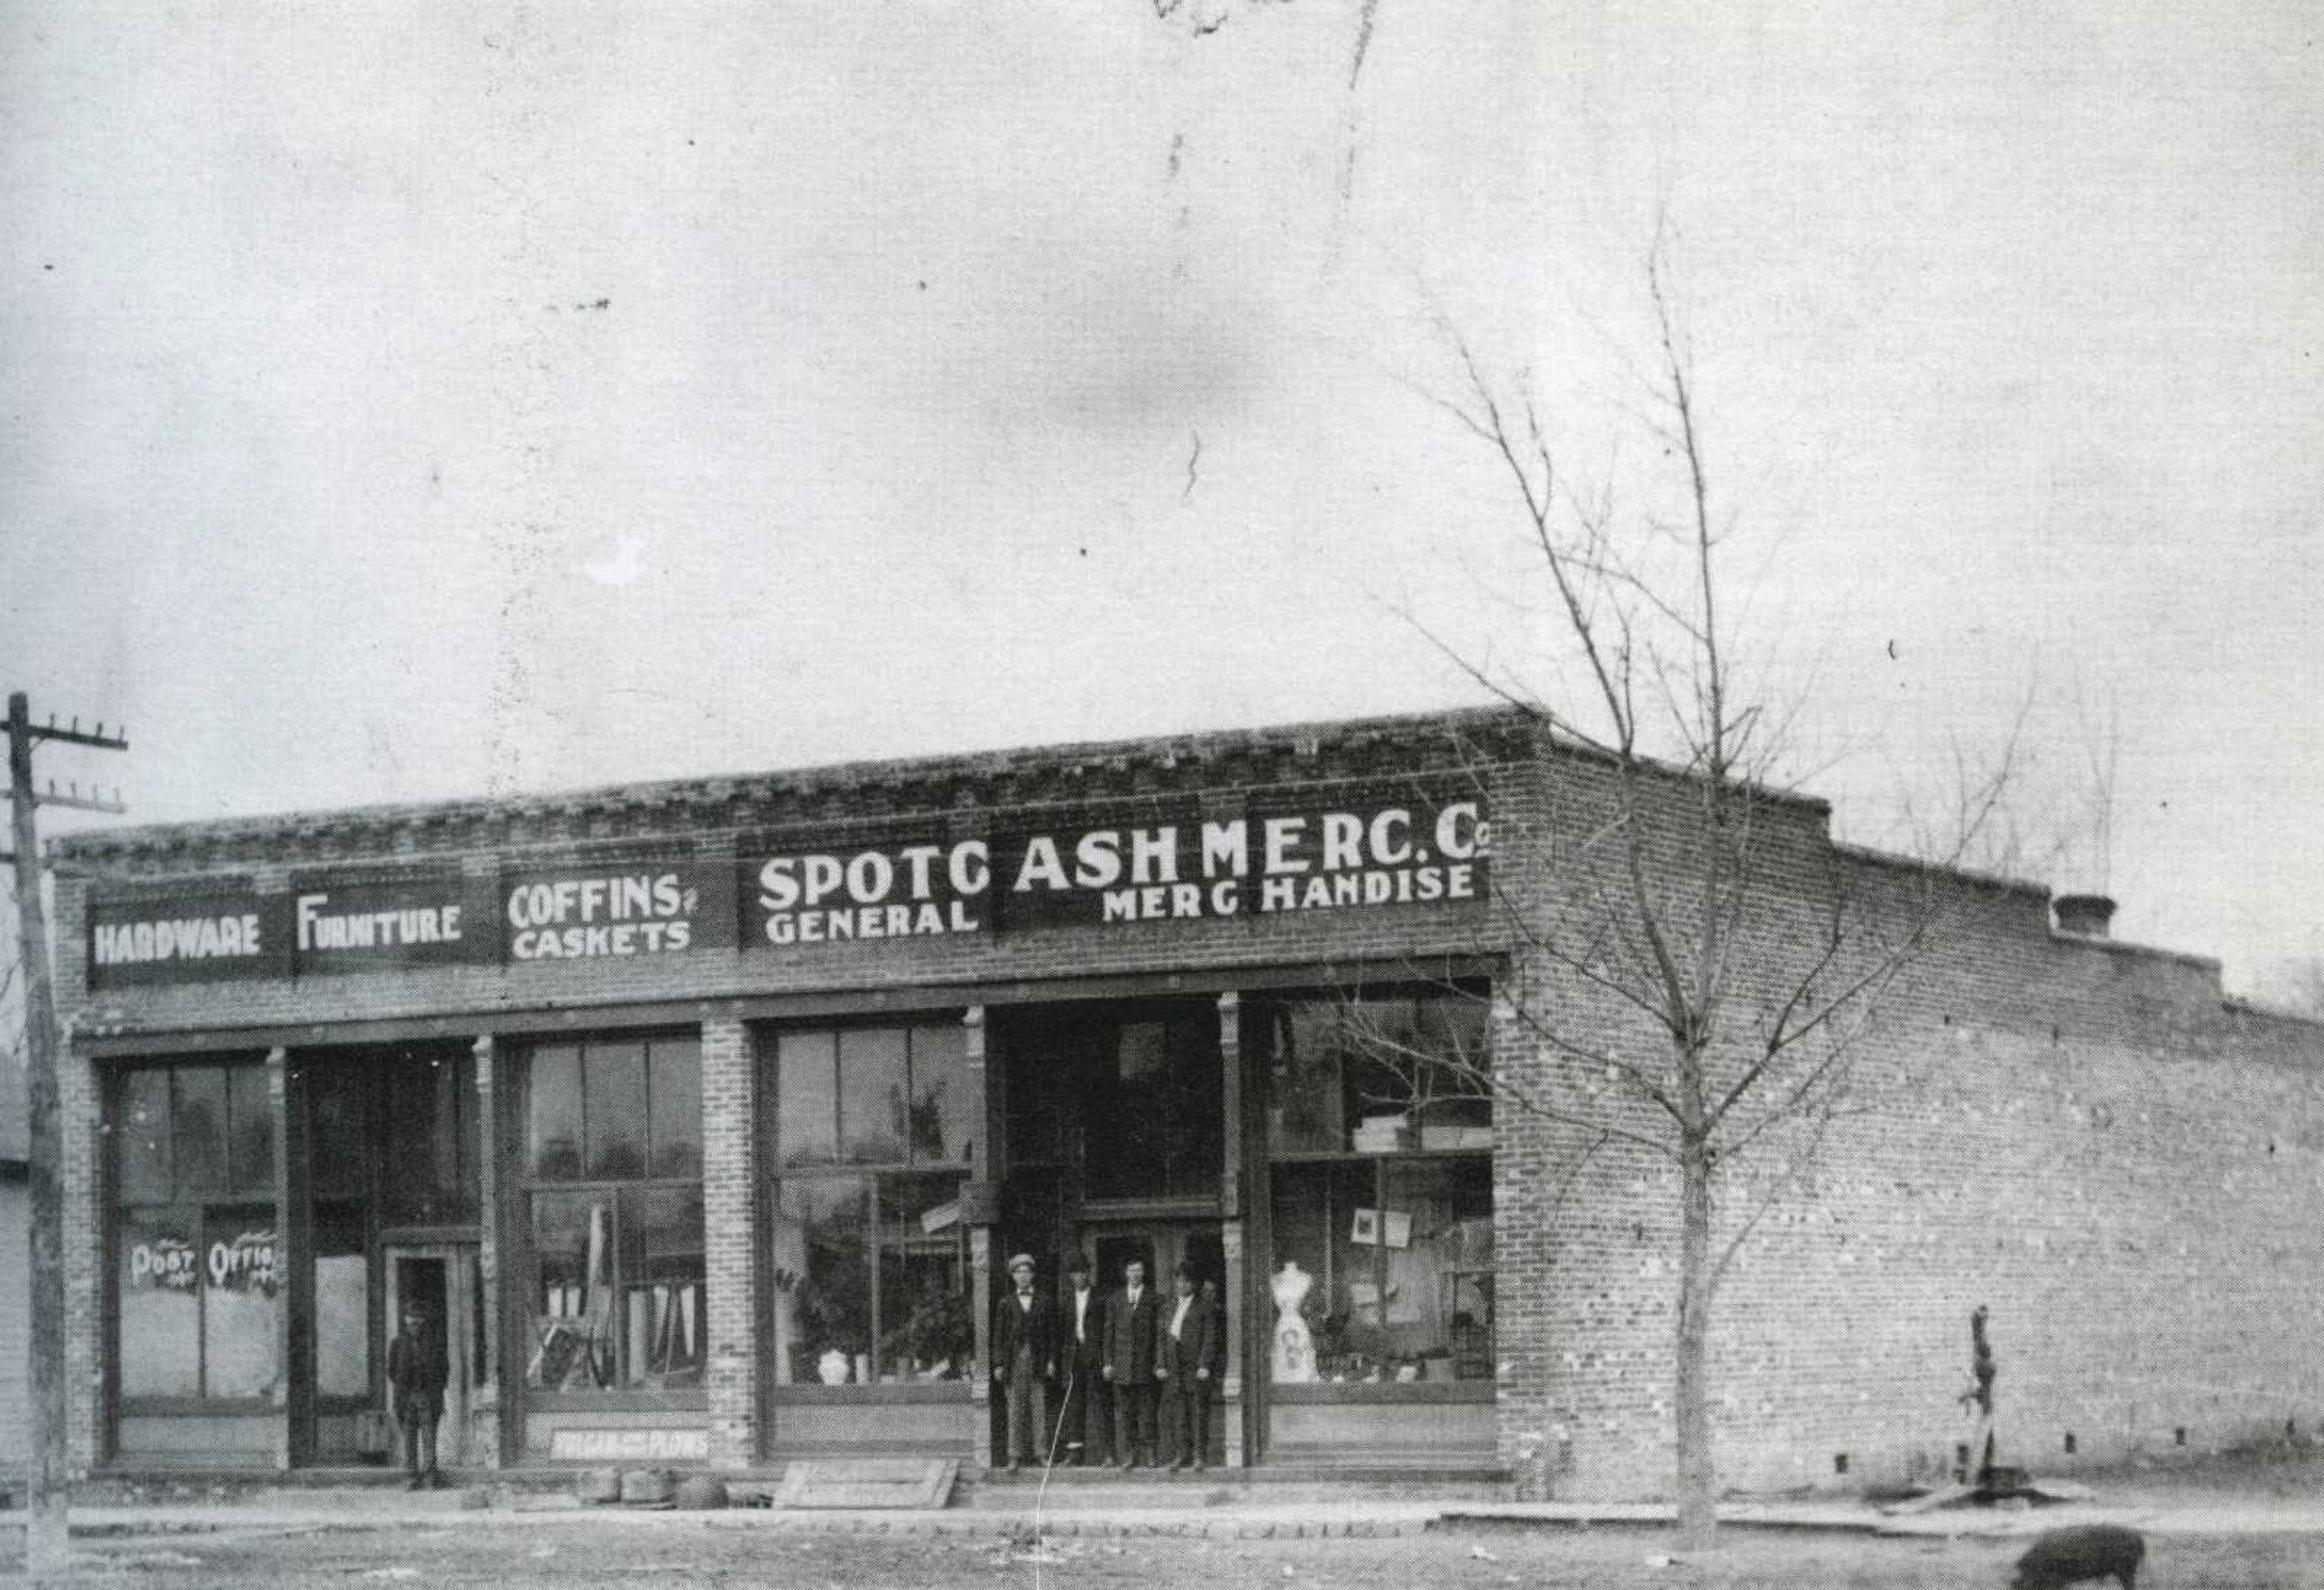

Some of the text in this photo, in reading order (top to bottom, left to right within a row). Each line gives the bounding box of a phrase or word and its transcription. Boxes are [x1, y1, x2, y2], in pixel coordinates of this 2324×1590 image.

[758, 845, 942, 910] SPOT
[1201, 808, 1429, 878] MERC.
[94, 913, 260, 964] HARDWARE
[513, 920, 691, 959] CASKETS
[765, 900, 980, 945] GENERAL
